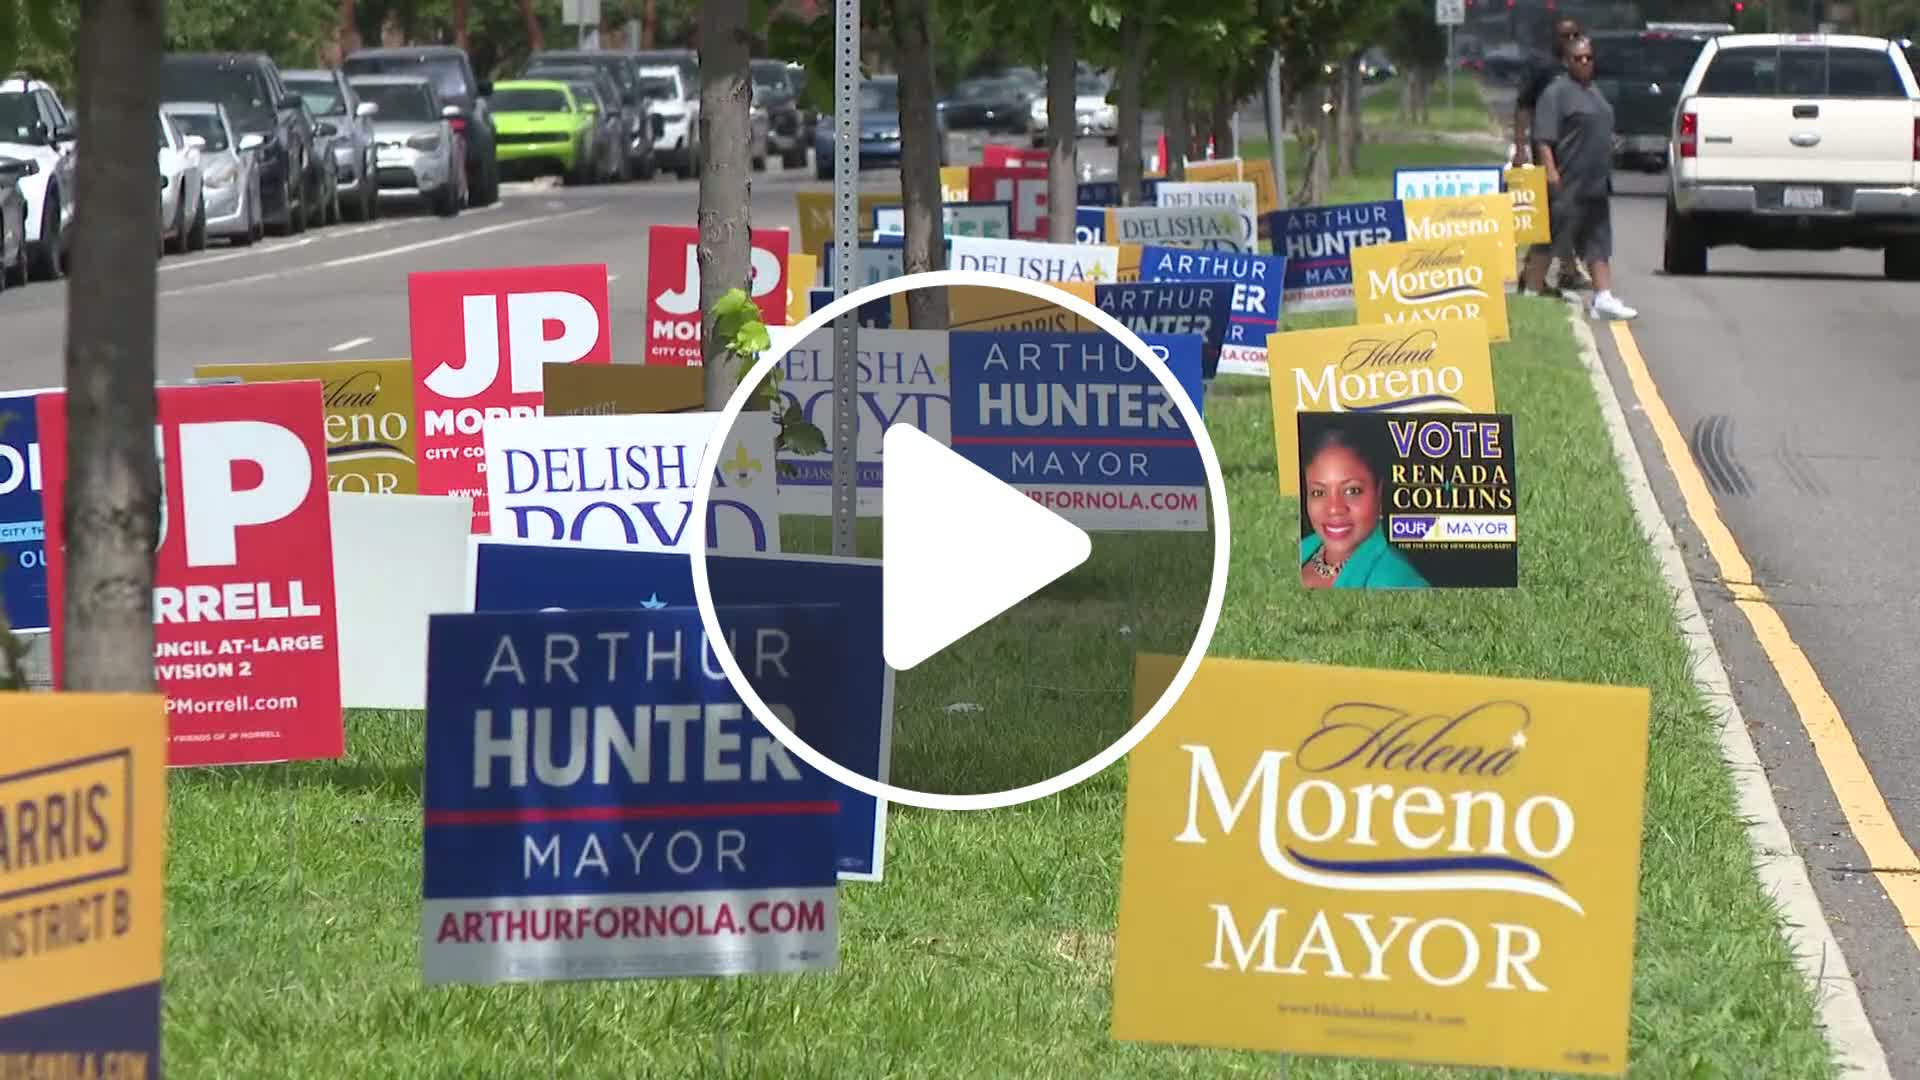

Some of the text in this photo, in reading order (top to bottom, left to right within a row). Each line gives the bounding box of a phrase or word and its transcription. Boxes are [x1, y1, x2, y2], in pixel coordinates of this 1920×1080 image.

[1122, 215, 1217, 239] DELISHA
[1286, 206, 1387, 231] ARTHUR
[1285, 227, 1393, 259] HUNTER
[1157, 253, 1267, 280] ARTHUR
[1305, 267, 1349, 285] MAY
[1367, 265, 1484, 303] Moreno
[1101, 288, 1214, 310] ARTHUR
[423, 290, 600, 399] JP
[651, 347, 676, 357] CITY
[1340, 329, 1438, 371] Helena
[978, 382, 1181, 429] HUNTER
[1291, 364, 1464, 412] Moreno
[425, 446, 460, 460] CITY
[1387, 419, 1503, 460] VOTE
[1011, 450, 1150, 478] MAYOR
[1392, 464, 1508, 485] RENADA
[1392, 486, 1512, 511] COLLINS
[1393, 520, 1509, 536] OUR MAYOR
[217, 635, 325, 655] AT-LARGE
[483, 628, 792, 688] ARTHUR
[238, 662, 252, 677] 2
[472, 702, 803, 790] HUNTER
[1296, 699, 1532, 778] Helena
[1173, 743, 1576, 873] Moreno
[523, 828, 748, 880] MAYOR
[113, 887, 131, 937] B
[436, 899, 826, 944] ARTHURFORNOLA.COM
[1203, 903, 1550, 993] MAYOR
